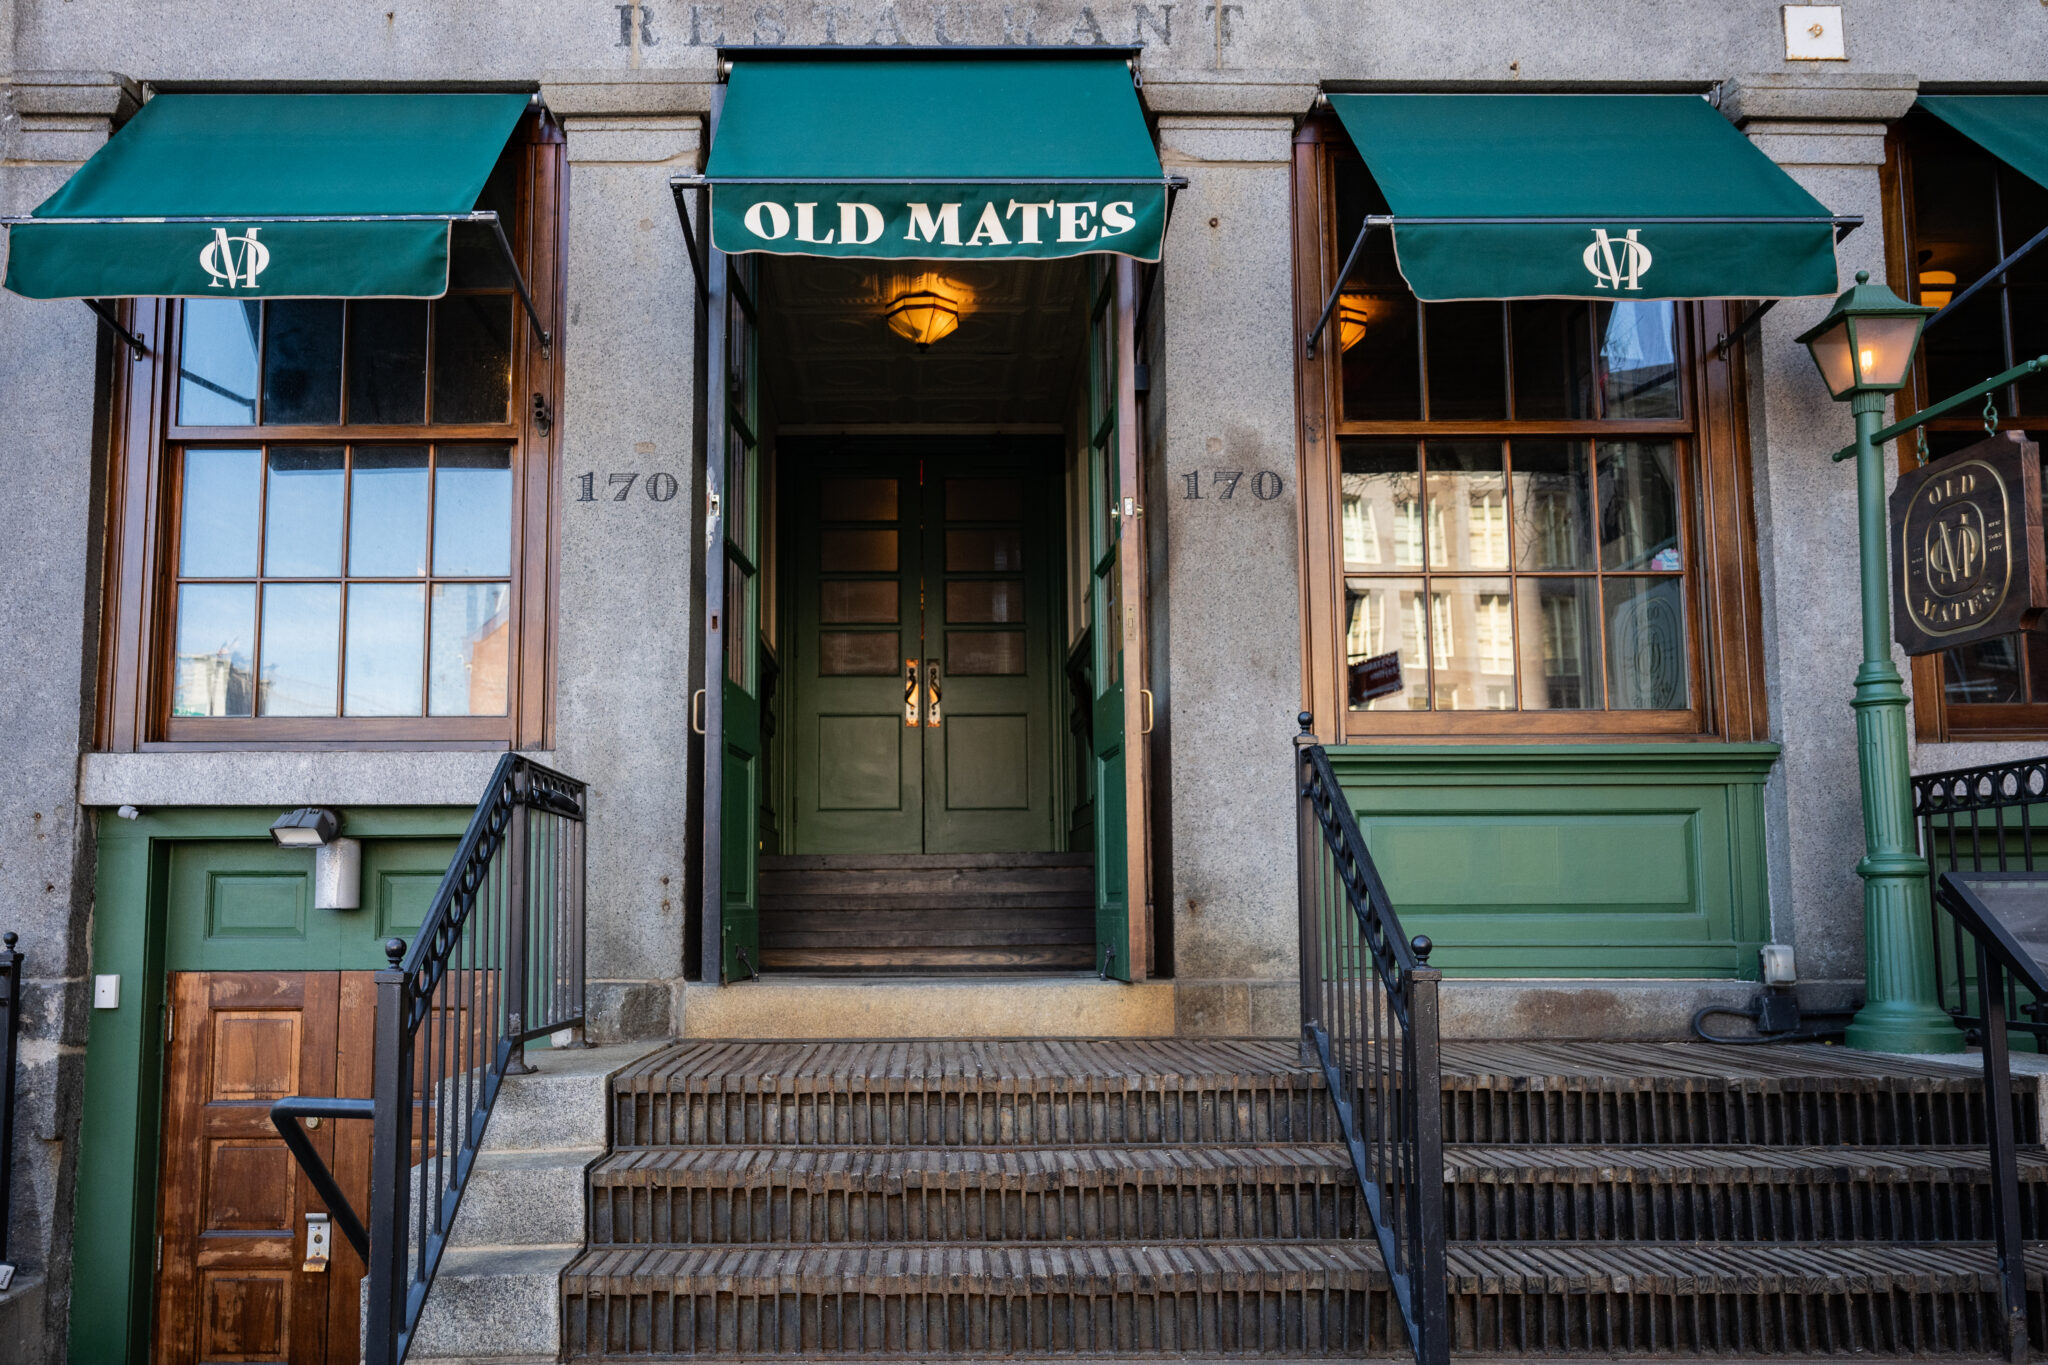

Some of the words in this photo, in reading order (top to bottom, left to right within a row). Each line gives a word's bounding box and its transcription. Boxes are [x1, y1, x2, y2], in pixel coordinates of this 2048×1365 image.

[614, 4, 1245, 47] RESTAURANT
[744, 201, 885, 245] OLD
[903, 198, 1137, 246] MATES
[576, 472, 679, 502] 170
[1181, 470, 1283, 500] 170
[1928, 474, 1976, 505] OLD
[1919, 582, 1996, 623] MATES
